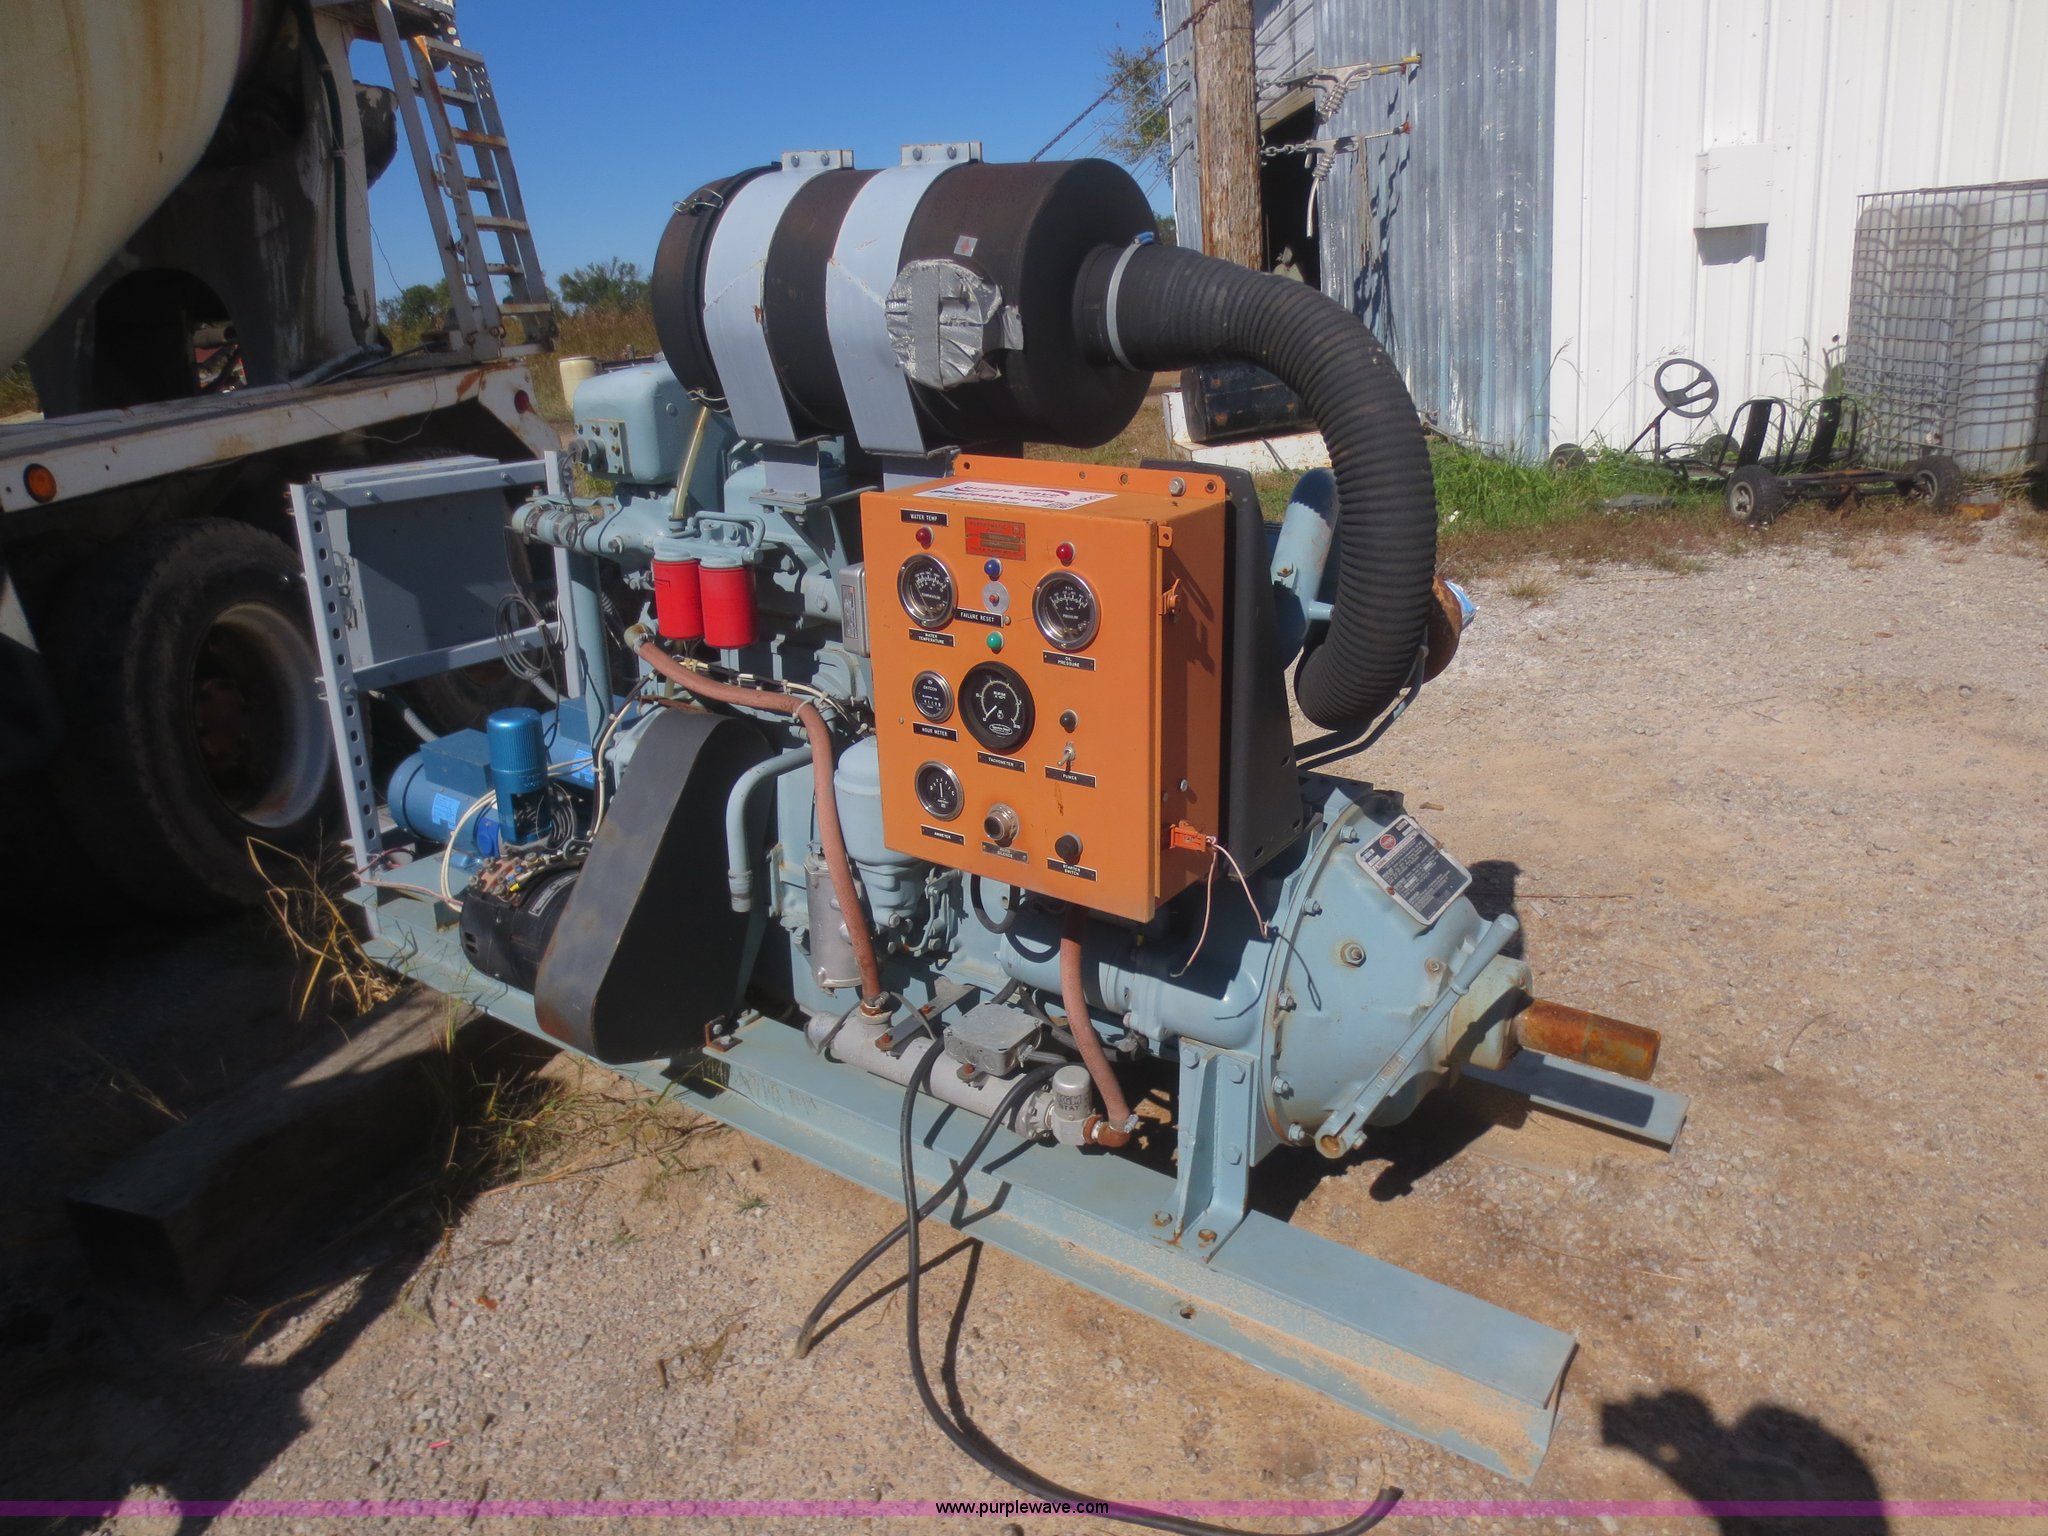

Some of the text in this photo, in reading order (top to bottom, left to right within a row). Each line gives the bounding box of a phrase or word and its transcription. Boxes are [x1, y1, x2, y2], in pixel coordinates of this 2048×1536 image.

[960, 611, 978, 620] FAILURE
[919, 636, 945, 644] TEMPERATURE
[988, 757, 1014, 767] TACHOMETER
[1062, 864, 1081, 873] STARTER
[1064, 868, 1080, 876] SWITCH
